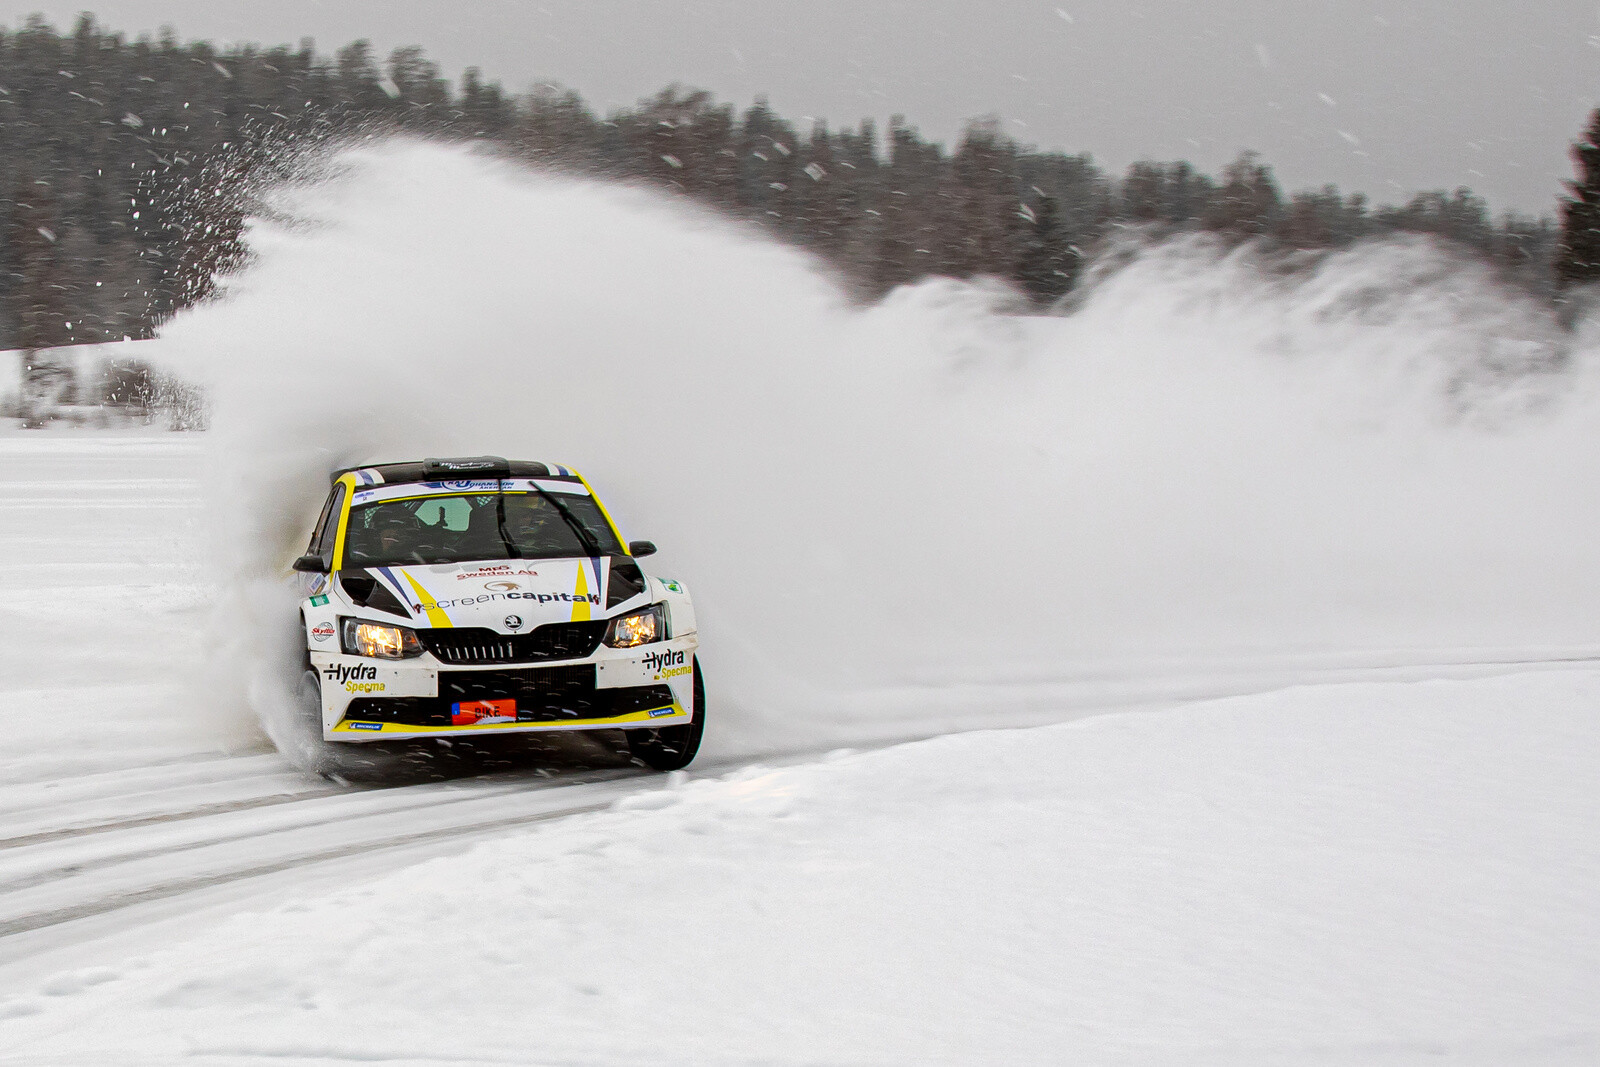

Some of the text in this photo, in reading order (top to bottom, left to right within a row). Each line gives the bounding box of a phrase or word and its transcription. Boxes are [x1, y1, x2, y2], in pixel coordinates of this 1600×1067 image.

[456, 571, 515, 581] Sweden
[641, 649, 684, 672] Hydra
[323, 663, 377, 685] Hydra
[661, 666, 693, 681] Specma
[345, 681, 385, 694] Specma
[474, 705, 501, 719] BIKE
